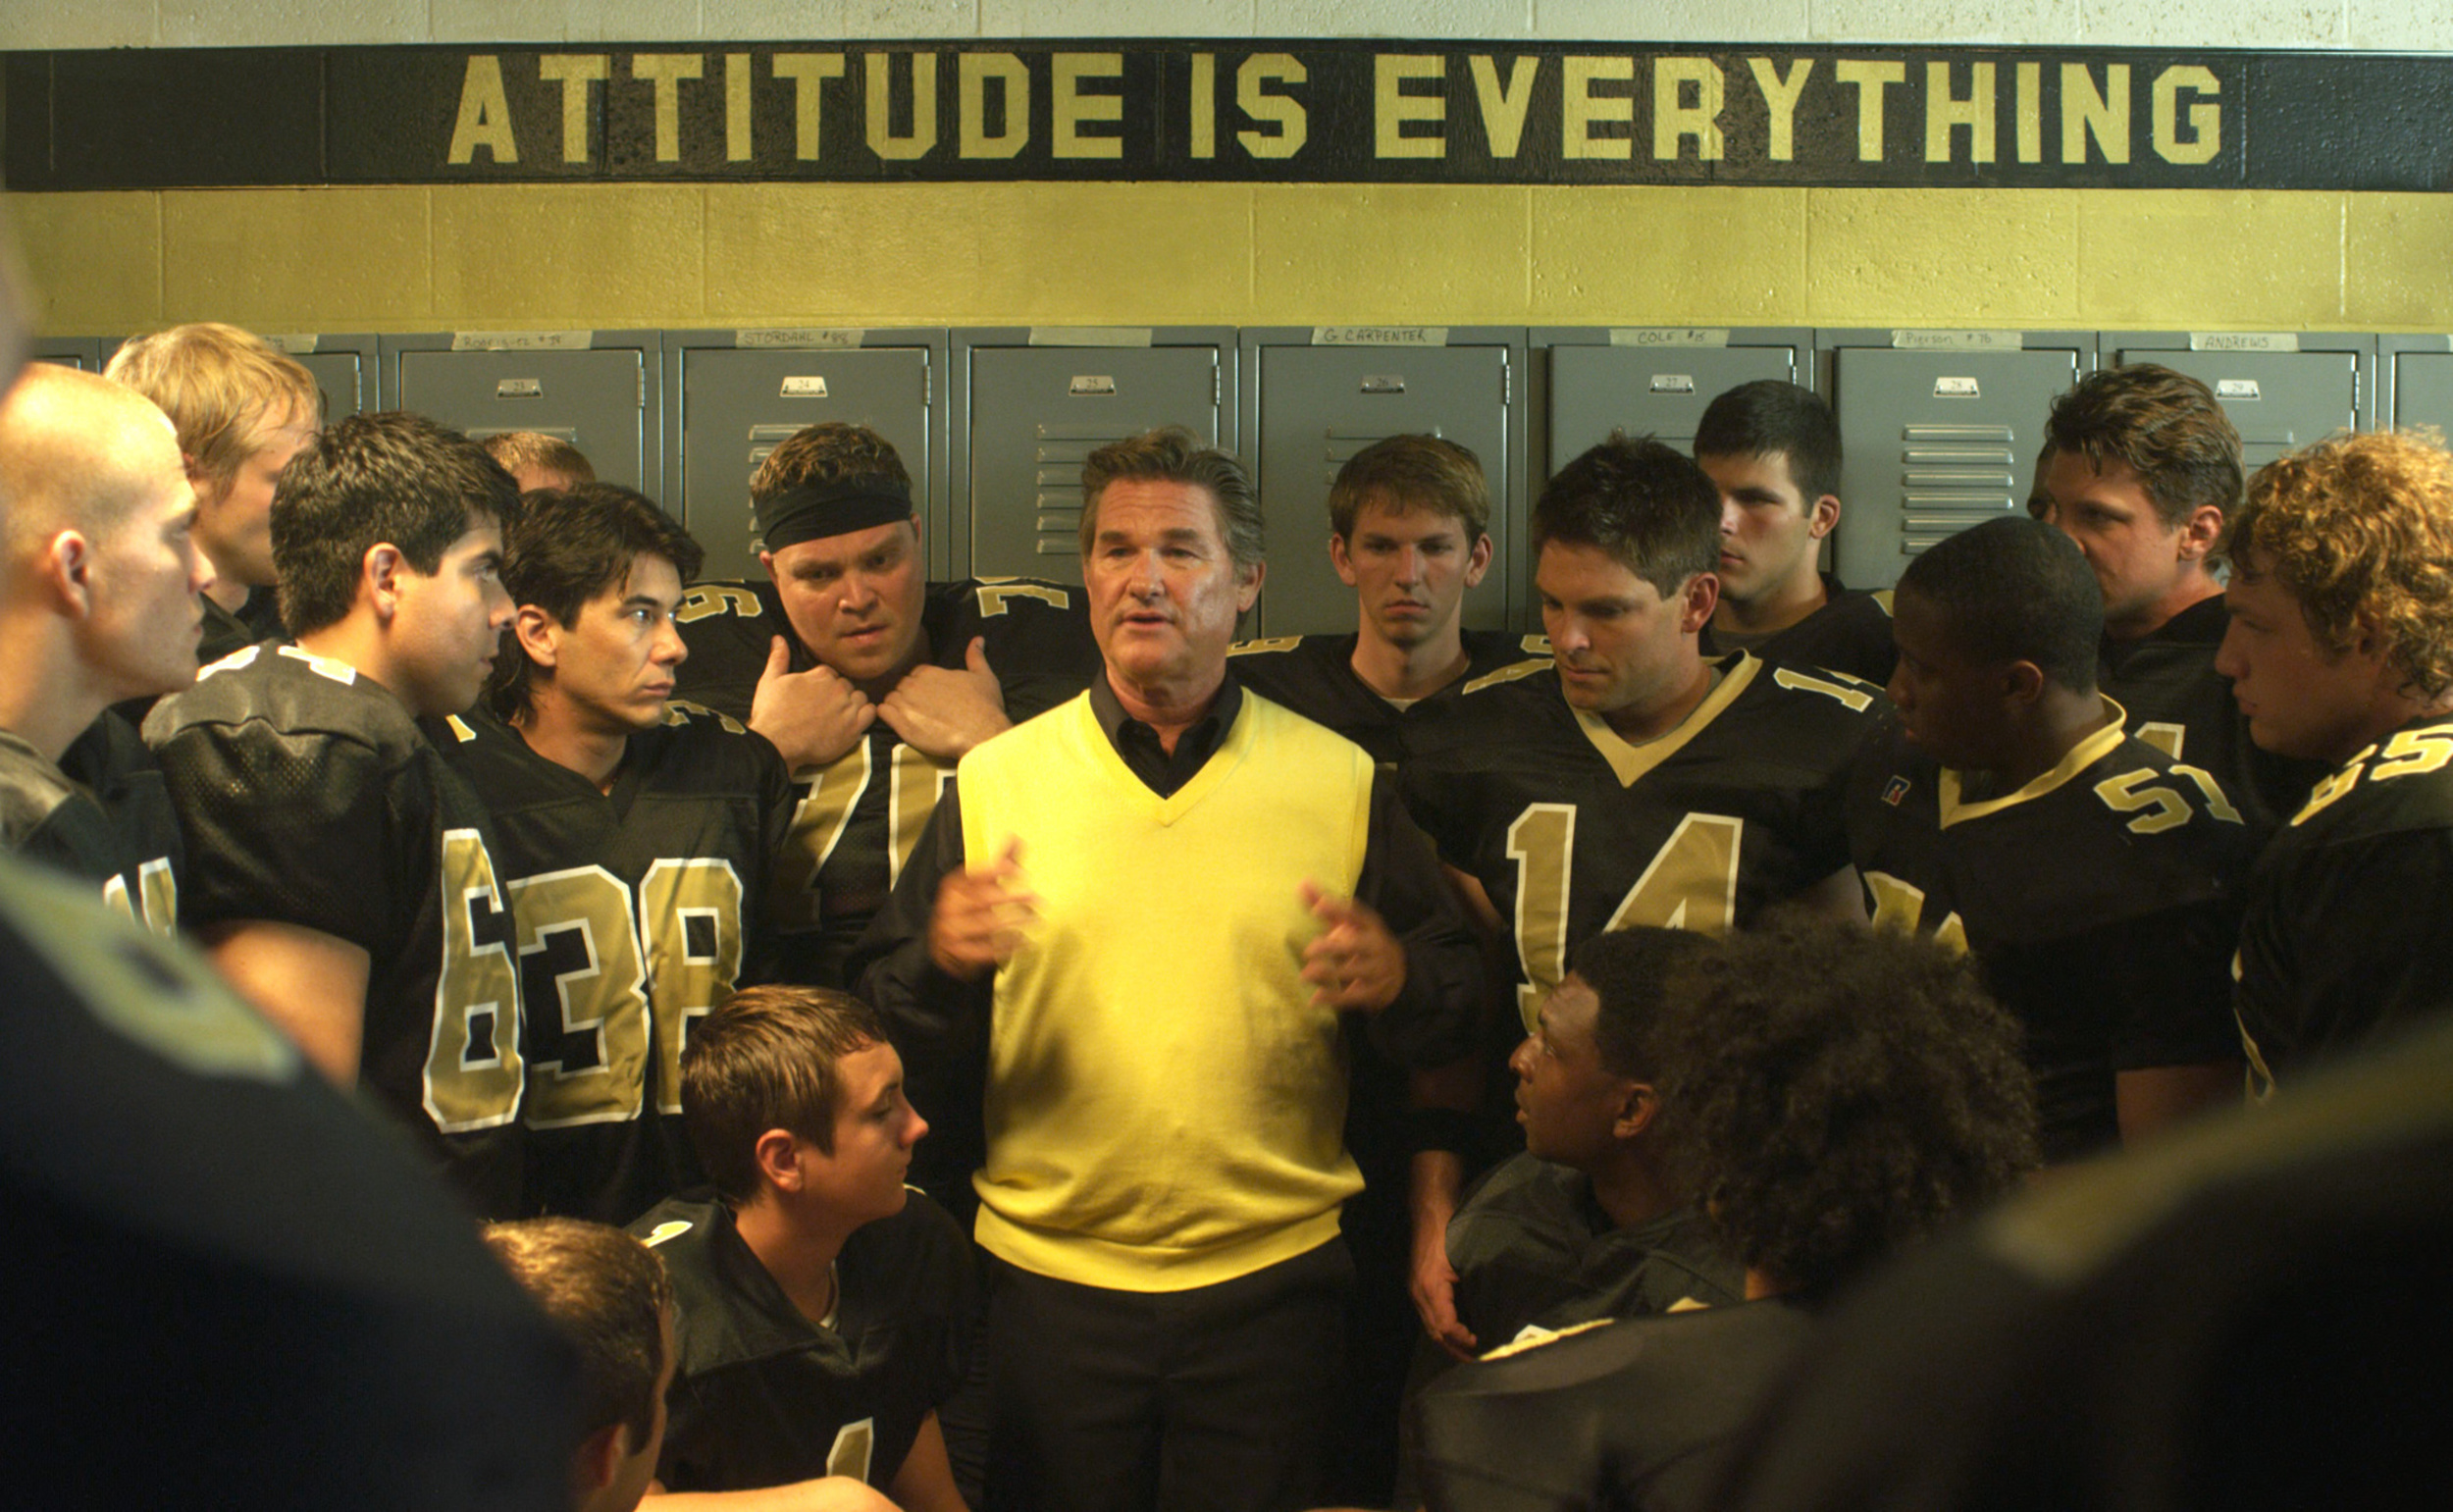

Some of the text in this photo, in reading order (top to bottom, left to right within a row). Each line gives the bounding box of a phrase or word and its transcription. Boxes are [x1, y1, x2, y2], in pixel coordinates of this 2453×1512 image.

[447, 52, 2221, 166] ATTITUDE IS EVERYTHING
[1344, 329, 1427, 342] CARPENTER
[2205, 336, 2270, 349] ANDREWS
